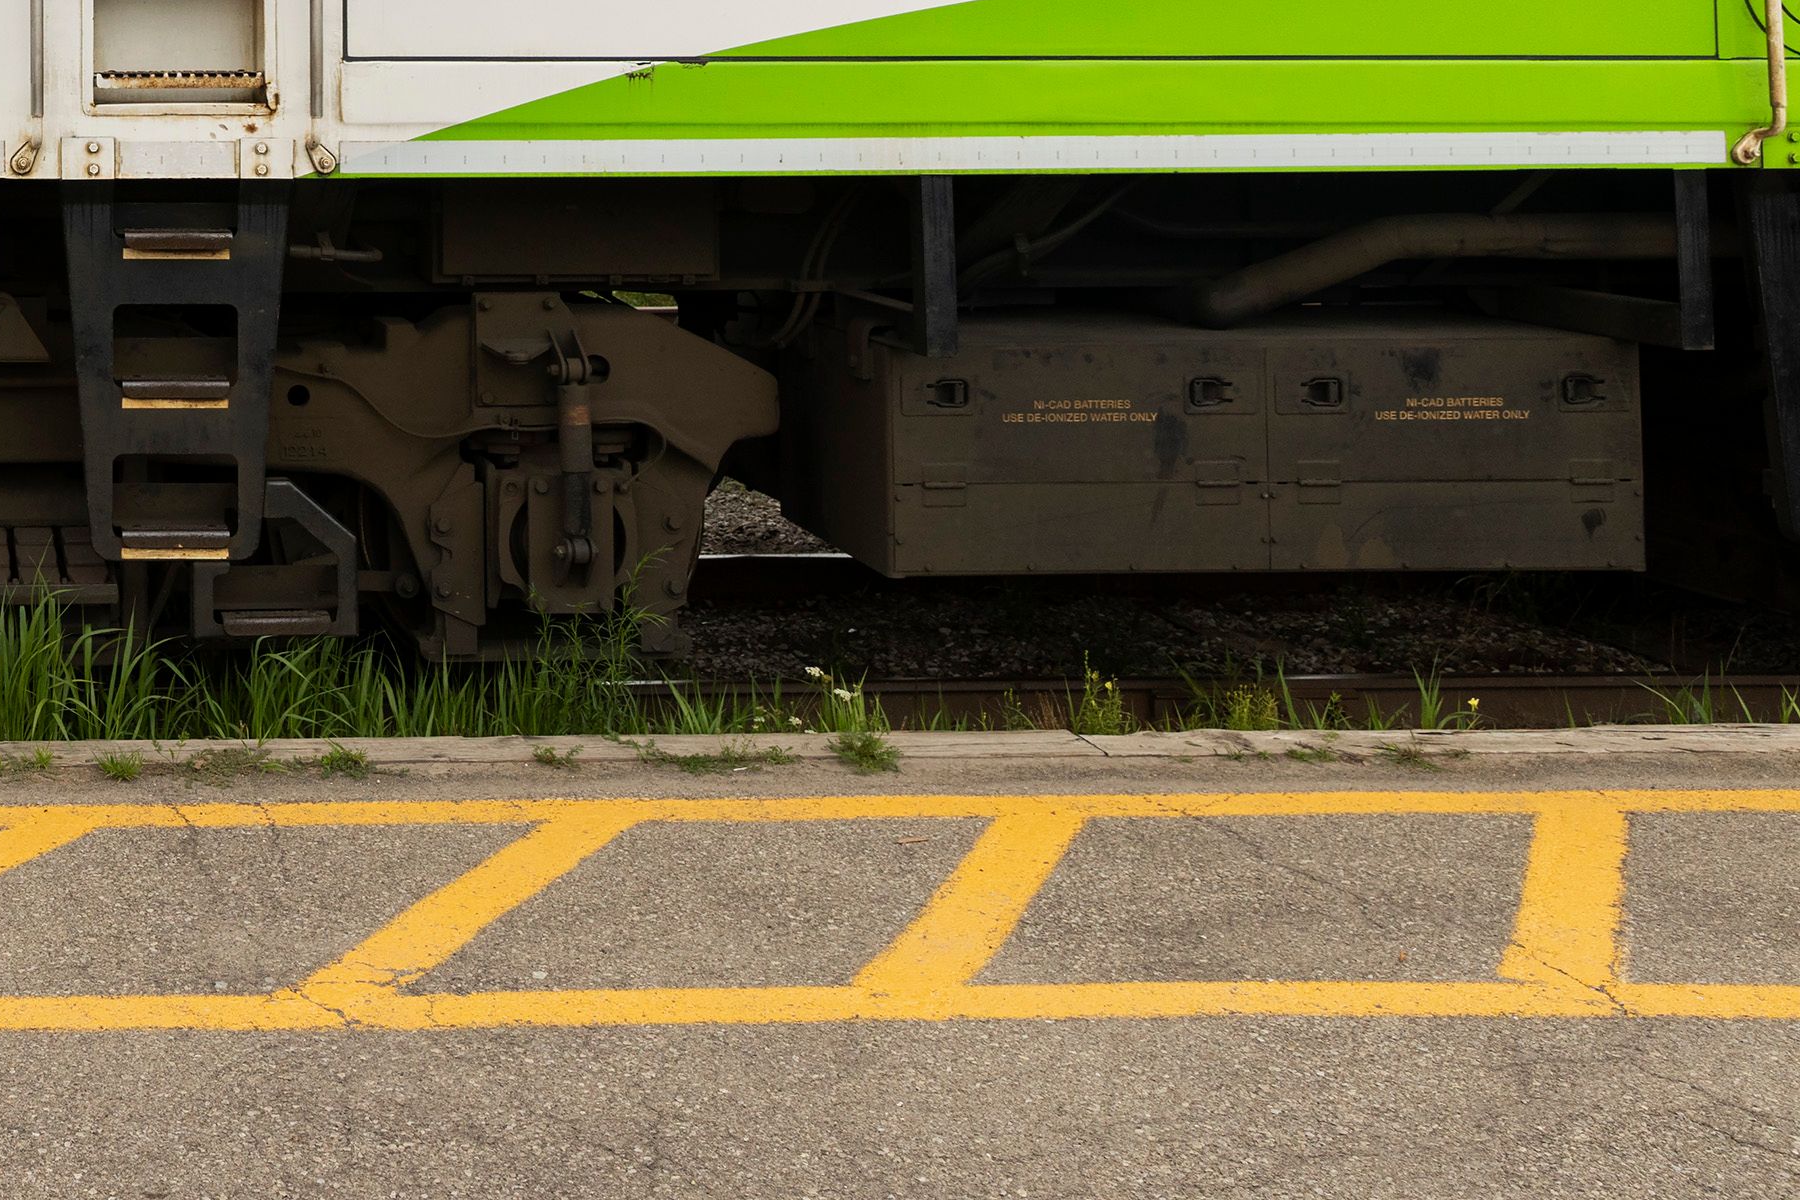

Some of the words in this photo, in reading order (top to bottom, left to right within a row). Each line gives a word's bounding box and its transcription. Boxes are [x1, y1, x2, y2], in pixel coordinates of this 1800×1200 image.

[1033, 399, 1071, 409] NI-CAD
[1074, 399, 1132, 409] BATTERIES
[1406, 397, 1444, 407] NI-CAD
[1447, 397, 1504, 407] BATTERIES
[1002, 413, 1024, 423] USE
[1026, 412, 1088, 422] DE-IONIZED
[1090, 412, 1127, 422] WATER
[1130, 412, 1158, 422] ONLY
[1375, 411, 1397, 420] USE
[1399, 410, 1460, 420] DE-IONIZED
[1462, 410, 1500, 420] WATER
[1502, 410, 1530, 419] ONLY
